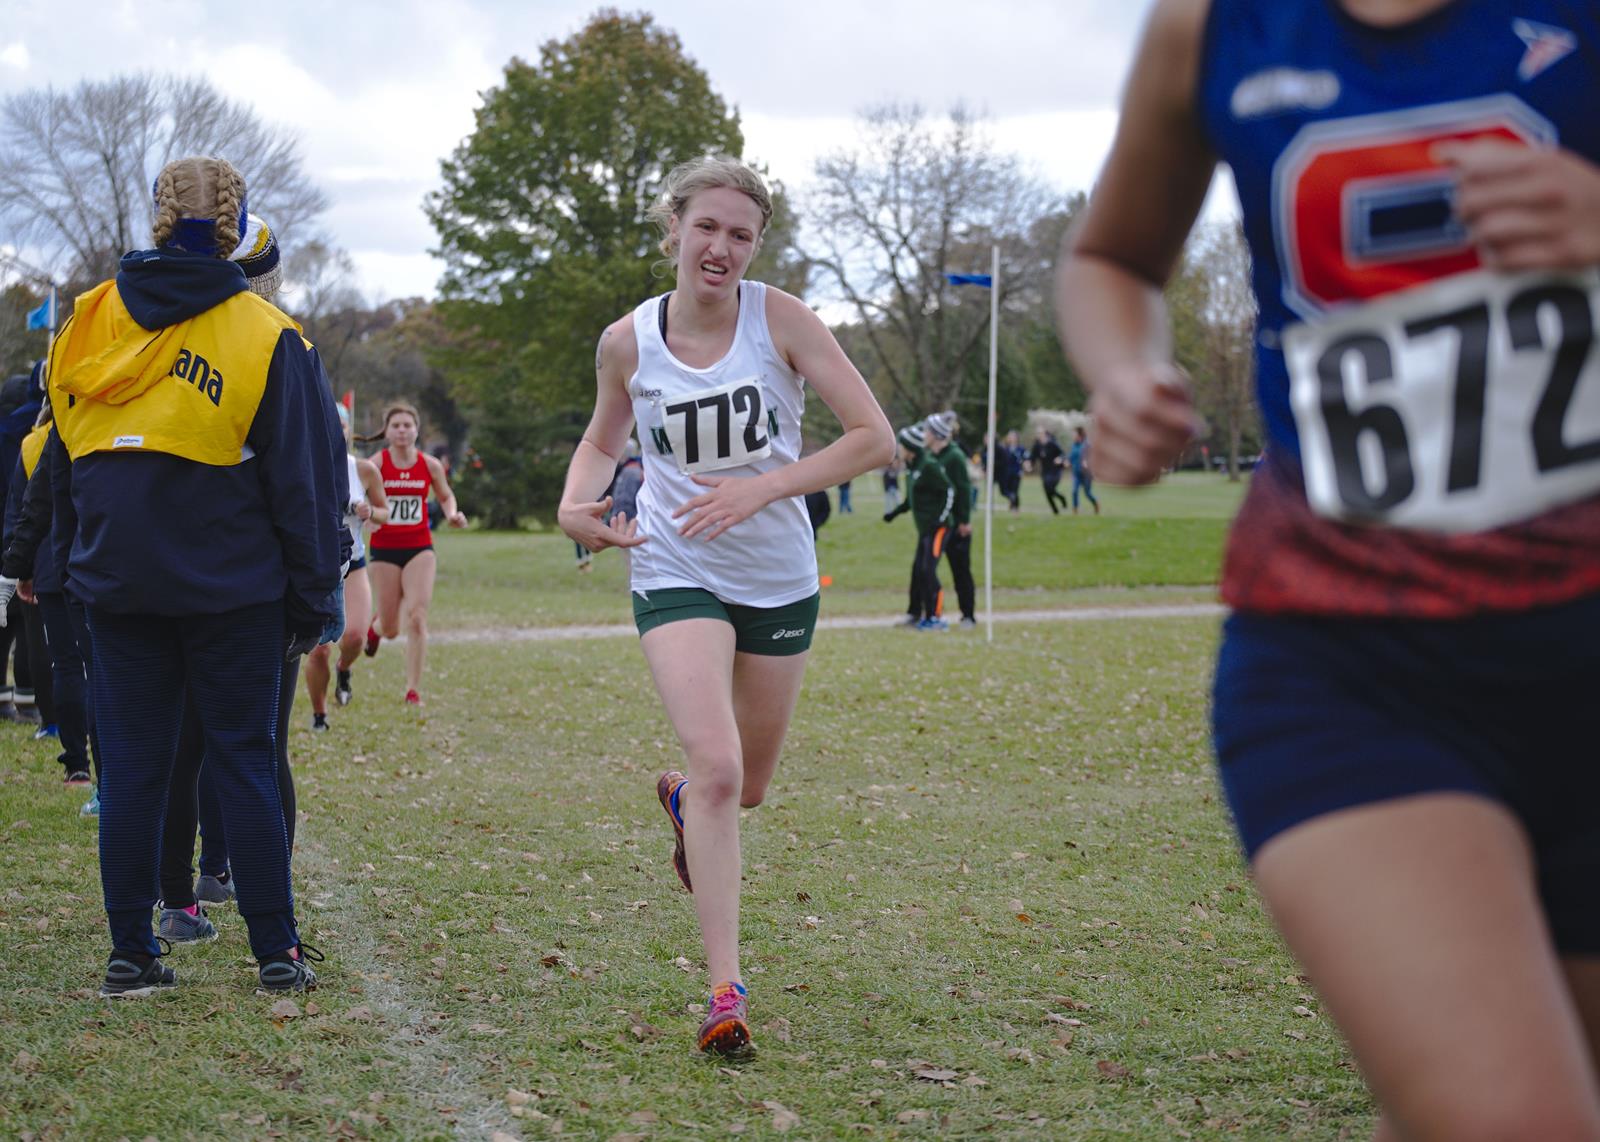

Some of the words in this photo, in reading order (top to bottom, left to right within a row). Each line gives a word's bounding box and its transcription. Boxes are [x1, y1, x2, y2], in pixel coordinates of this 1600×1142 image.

[1316, 284, 1600, 512] 672
[665, 385, 769, 464] 772
[389, 499, 420, 521] 702
[784, 628, 806, 638] asics
